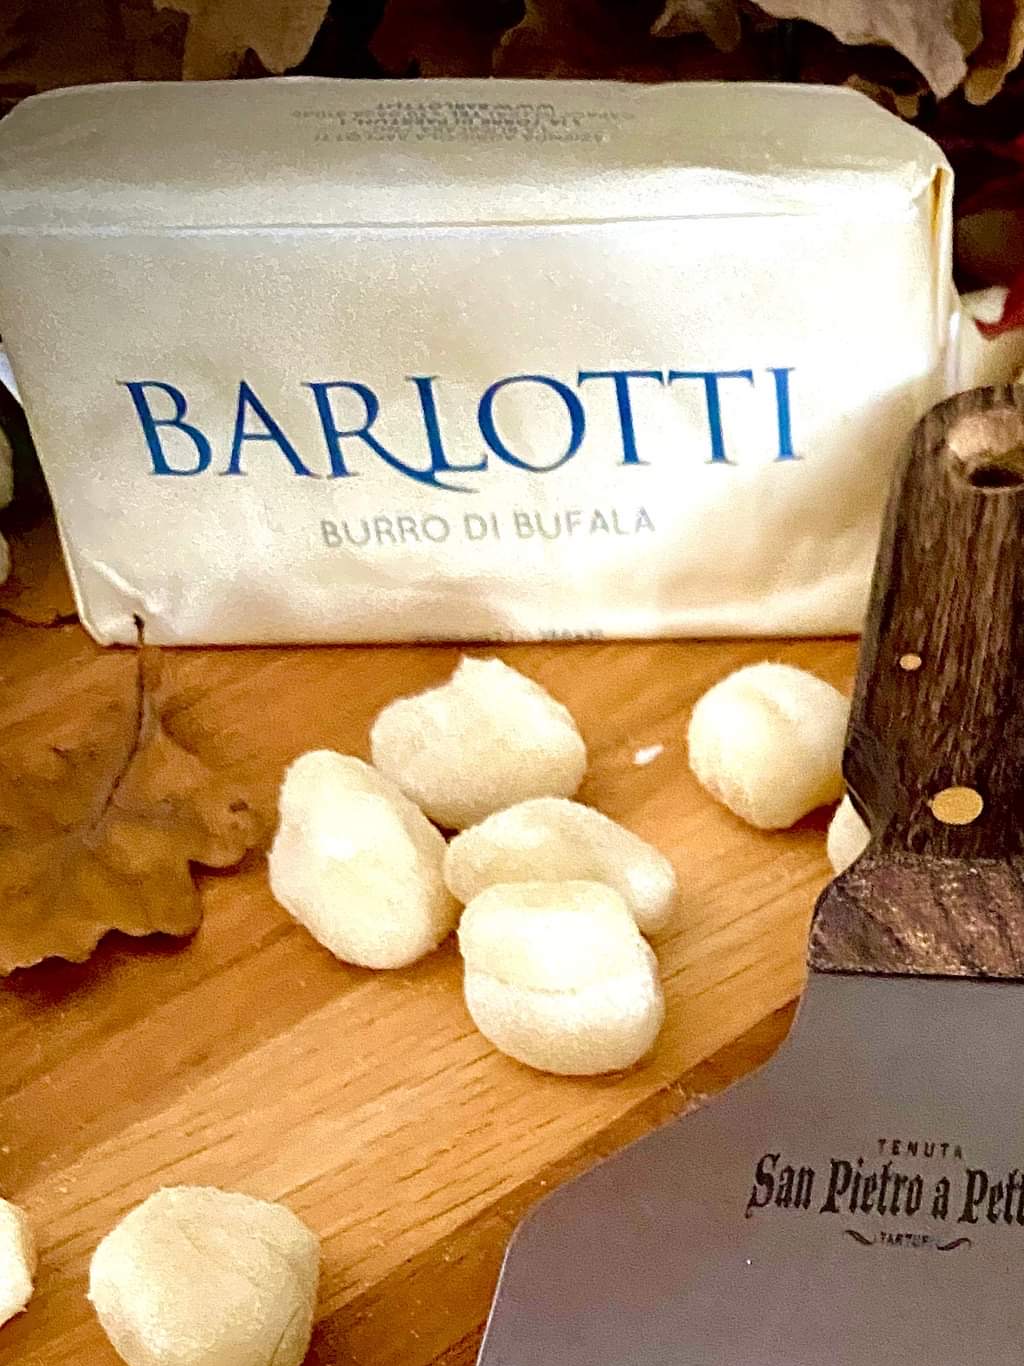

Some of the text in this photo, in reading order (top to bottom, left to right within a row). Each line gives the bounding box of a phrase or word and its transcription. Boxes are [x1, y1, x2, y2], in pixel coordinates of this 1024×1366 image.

[115, 367, 804, 493] BARLOTTI
[320, 506, 656, 547] BURRO DI BUFALA
[877, 1138, 963, 1160] TENUTA
[744, 1153, 816, 1219] San
[819, 1157, 924, 1217] Pietro
